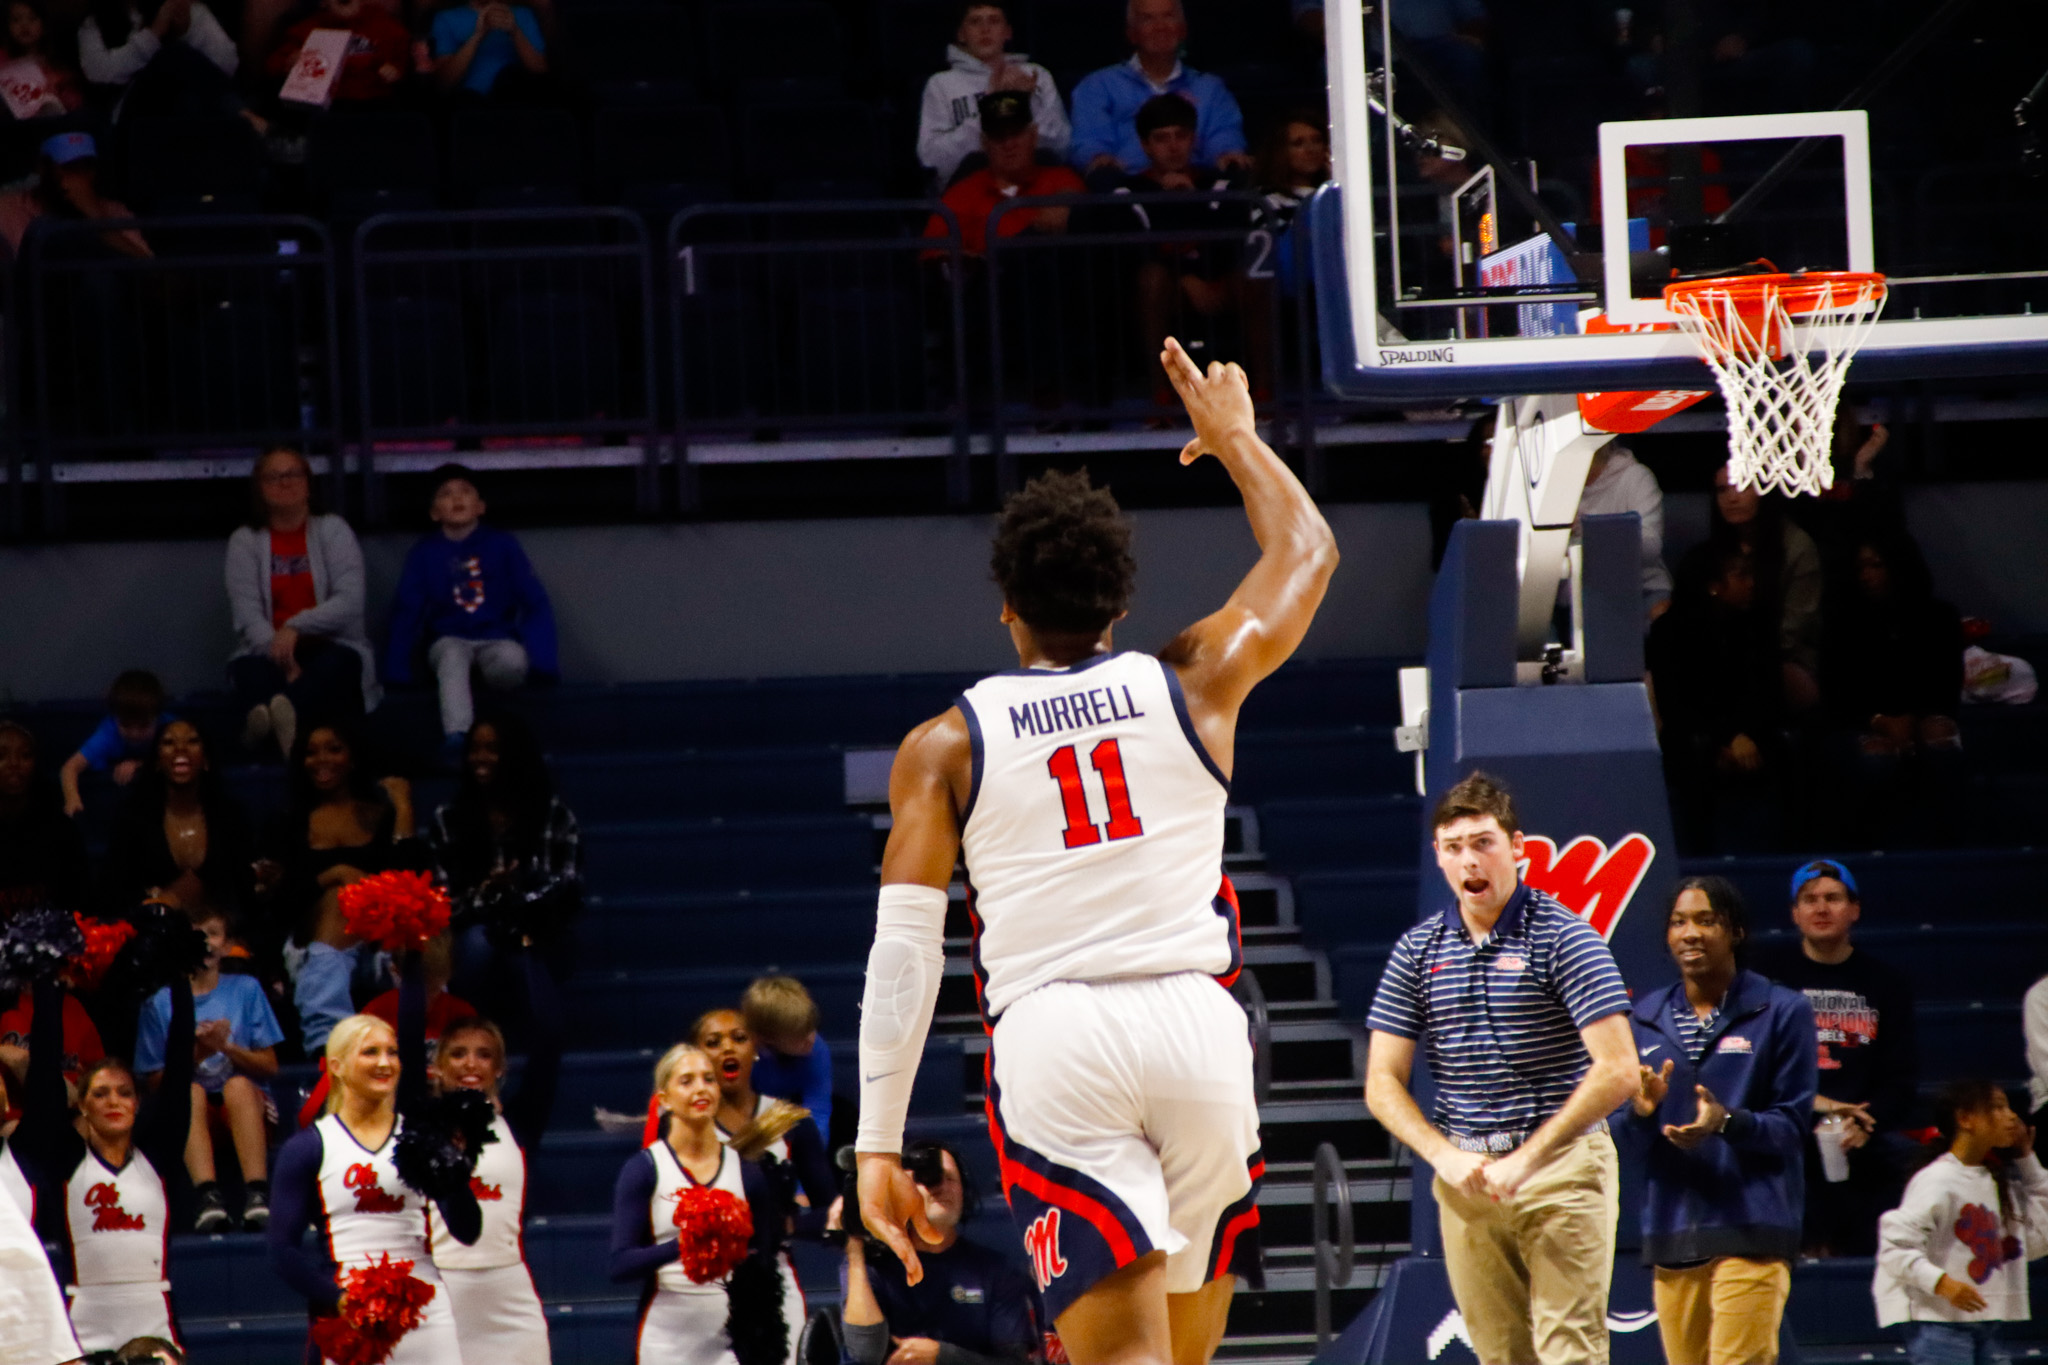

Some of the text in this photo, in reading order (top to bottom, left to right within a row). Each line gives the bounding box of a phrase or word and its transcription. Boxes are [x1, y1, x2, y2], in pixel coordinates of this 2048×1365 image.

[678, 245, 695, 295] 1
[1247, 229, 1275, 278] 2
[1379, 346, 1454, 367] SPALDING
[1008, 684, 1145, 739] MURRELL
[1047, 738, 1144, 850] 11
[84, 1182, 120, 1208] Ole
[343, 1163, 378, 1189] Ole
